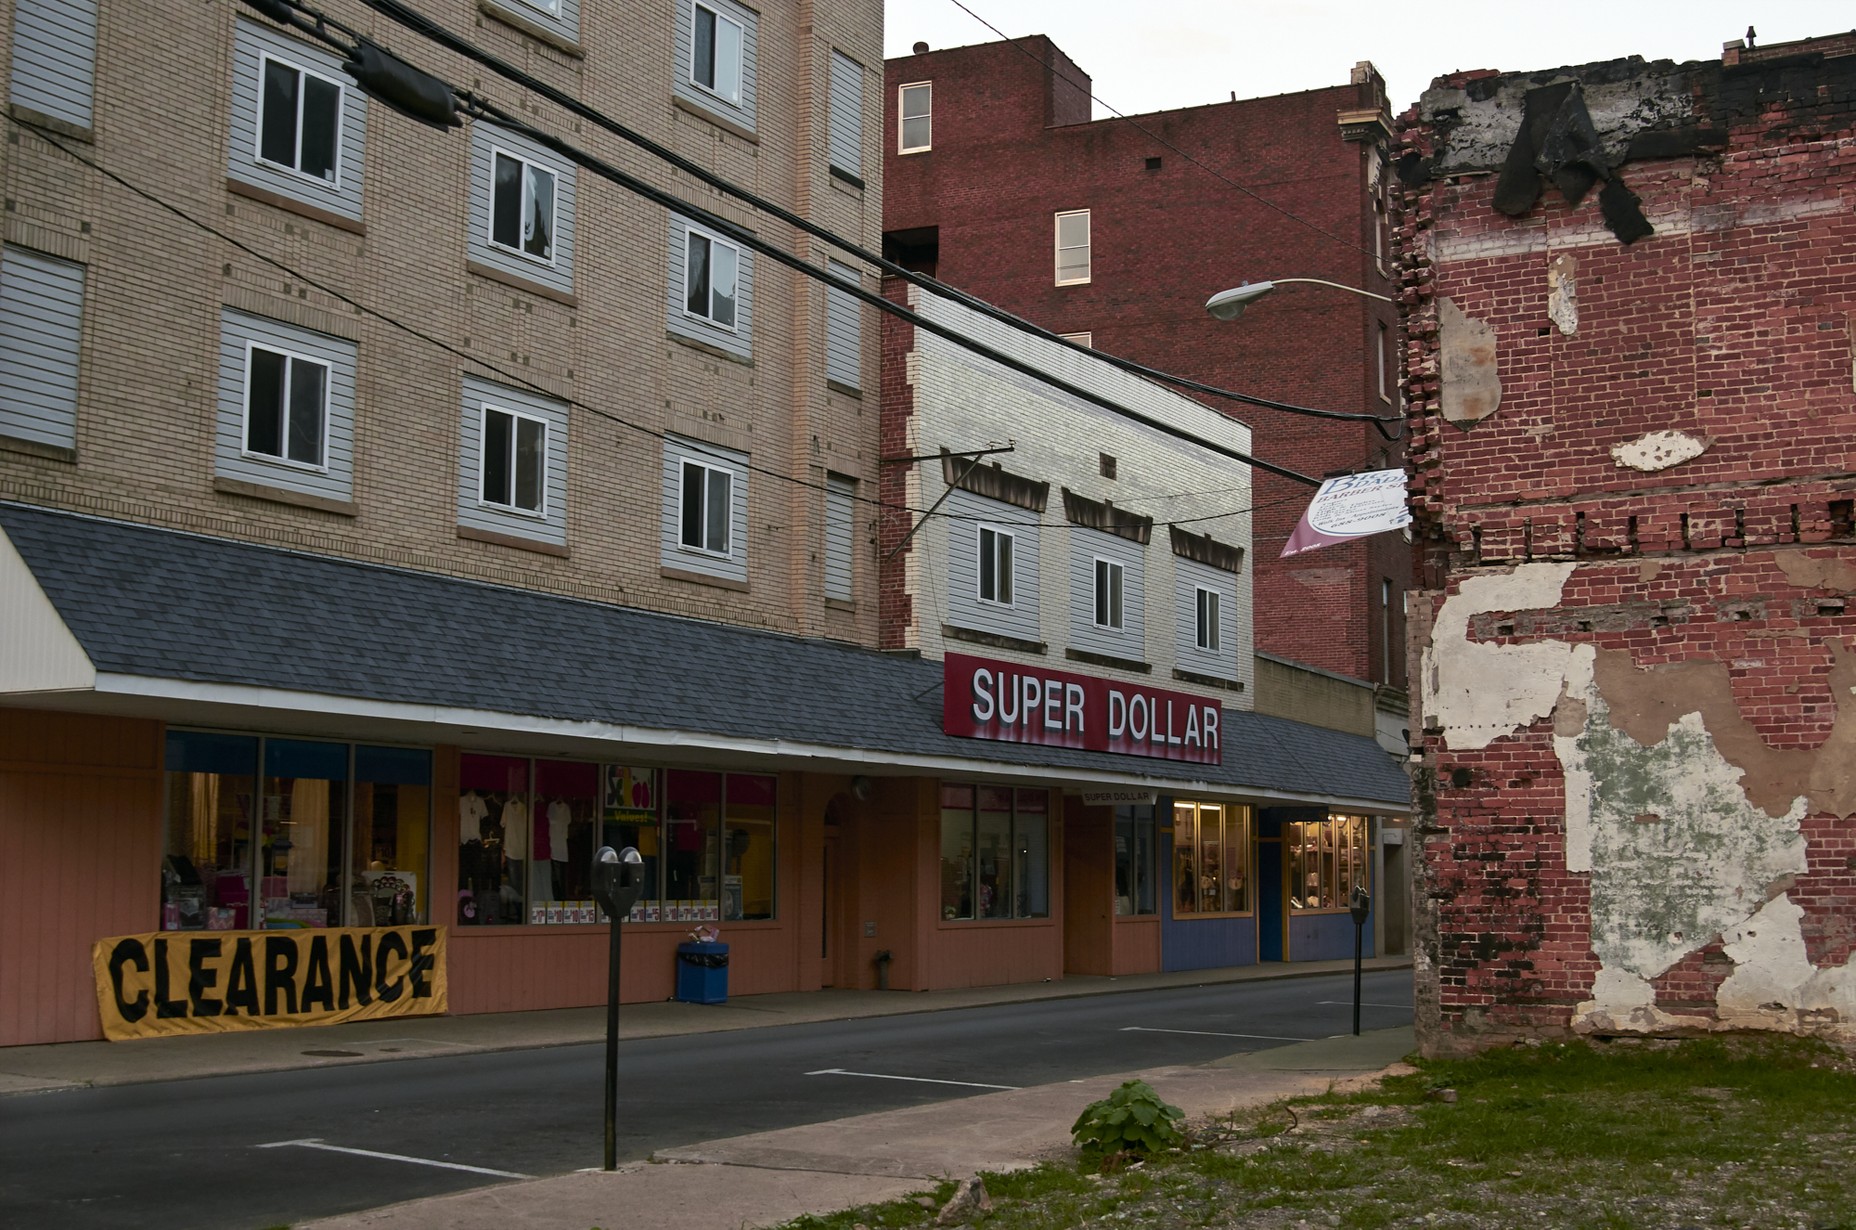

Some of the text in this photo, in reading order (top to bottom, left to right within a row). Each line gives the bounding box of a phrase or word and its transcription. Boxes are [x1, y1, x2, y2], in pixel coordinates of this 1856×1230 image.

[1316, 485, 1382, 504] BARBER
[1321, 471, 1390, 496] BIG
[972, 667, 1219, 749] SUPER DOLLAR
[1084, 791, 1150, 801] SUPER DOLLAR
[109, 928, 437, 1023] CLEARANCE
